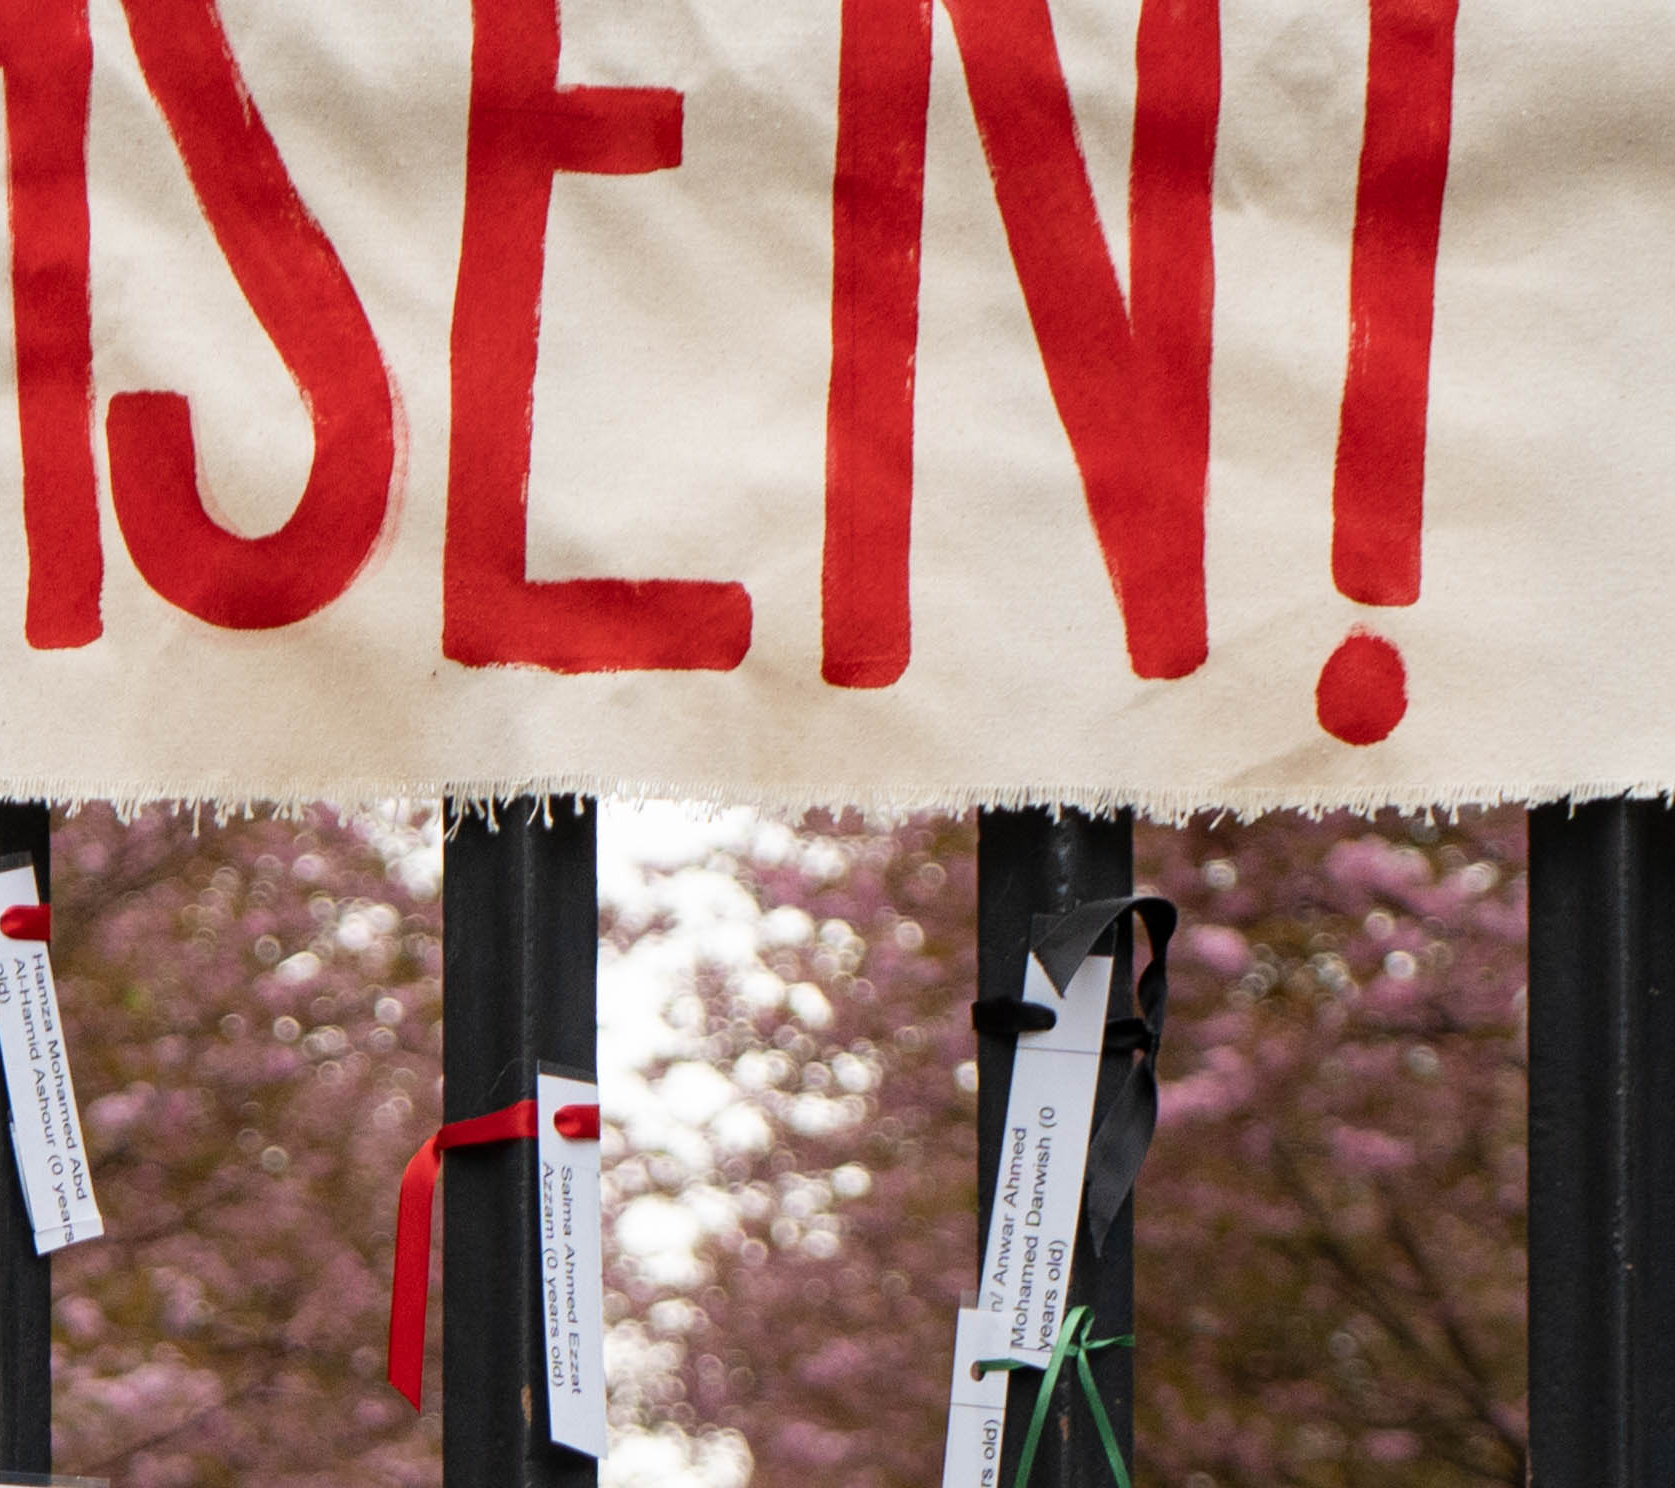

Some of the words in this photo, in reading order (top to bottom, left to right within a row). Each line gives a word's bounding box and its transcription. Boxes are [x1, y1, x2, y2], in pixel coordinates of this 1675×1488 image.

[14, 958, 42, 1061] Al-Hamid
[31, 953, 55, 1033] Hamza
[47, 1039, 77, 1150] Mohamed
[69, 1157, 88, 1201] Abd
[31, 1068, 56, 1147] Ashour
[1037, 1104, 1060, 1131] (0
[46, 1155, 64, 1176] (0
[999, 1126, 1028, 1206] Ahmed
[1023, 1137, 1053, 1228] Darwish
[49, 1183, 76, 1244] years
[987, 1213, 1016, 1286] Anwar
[1008, 1235, 1042, 1350] Mohamed
[1044, 1240, 1068, 1287] old)
[1035, 1292, 1062, 1353] years
[979, 1417, 1002, 1461] old)
